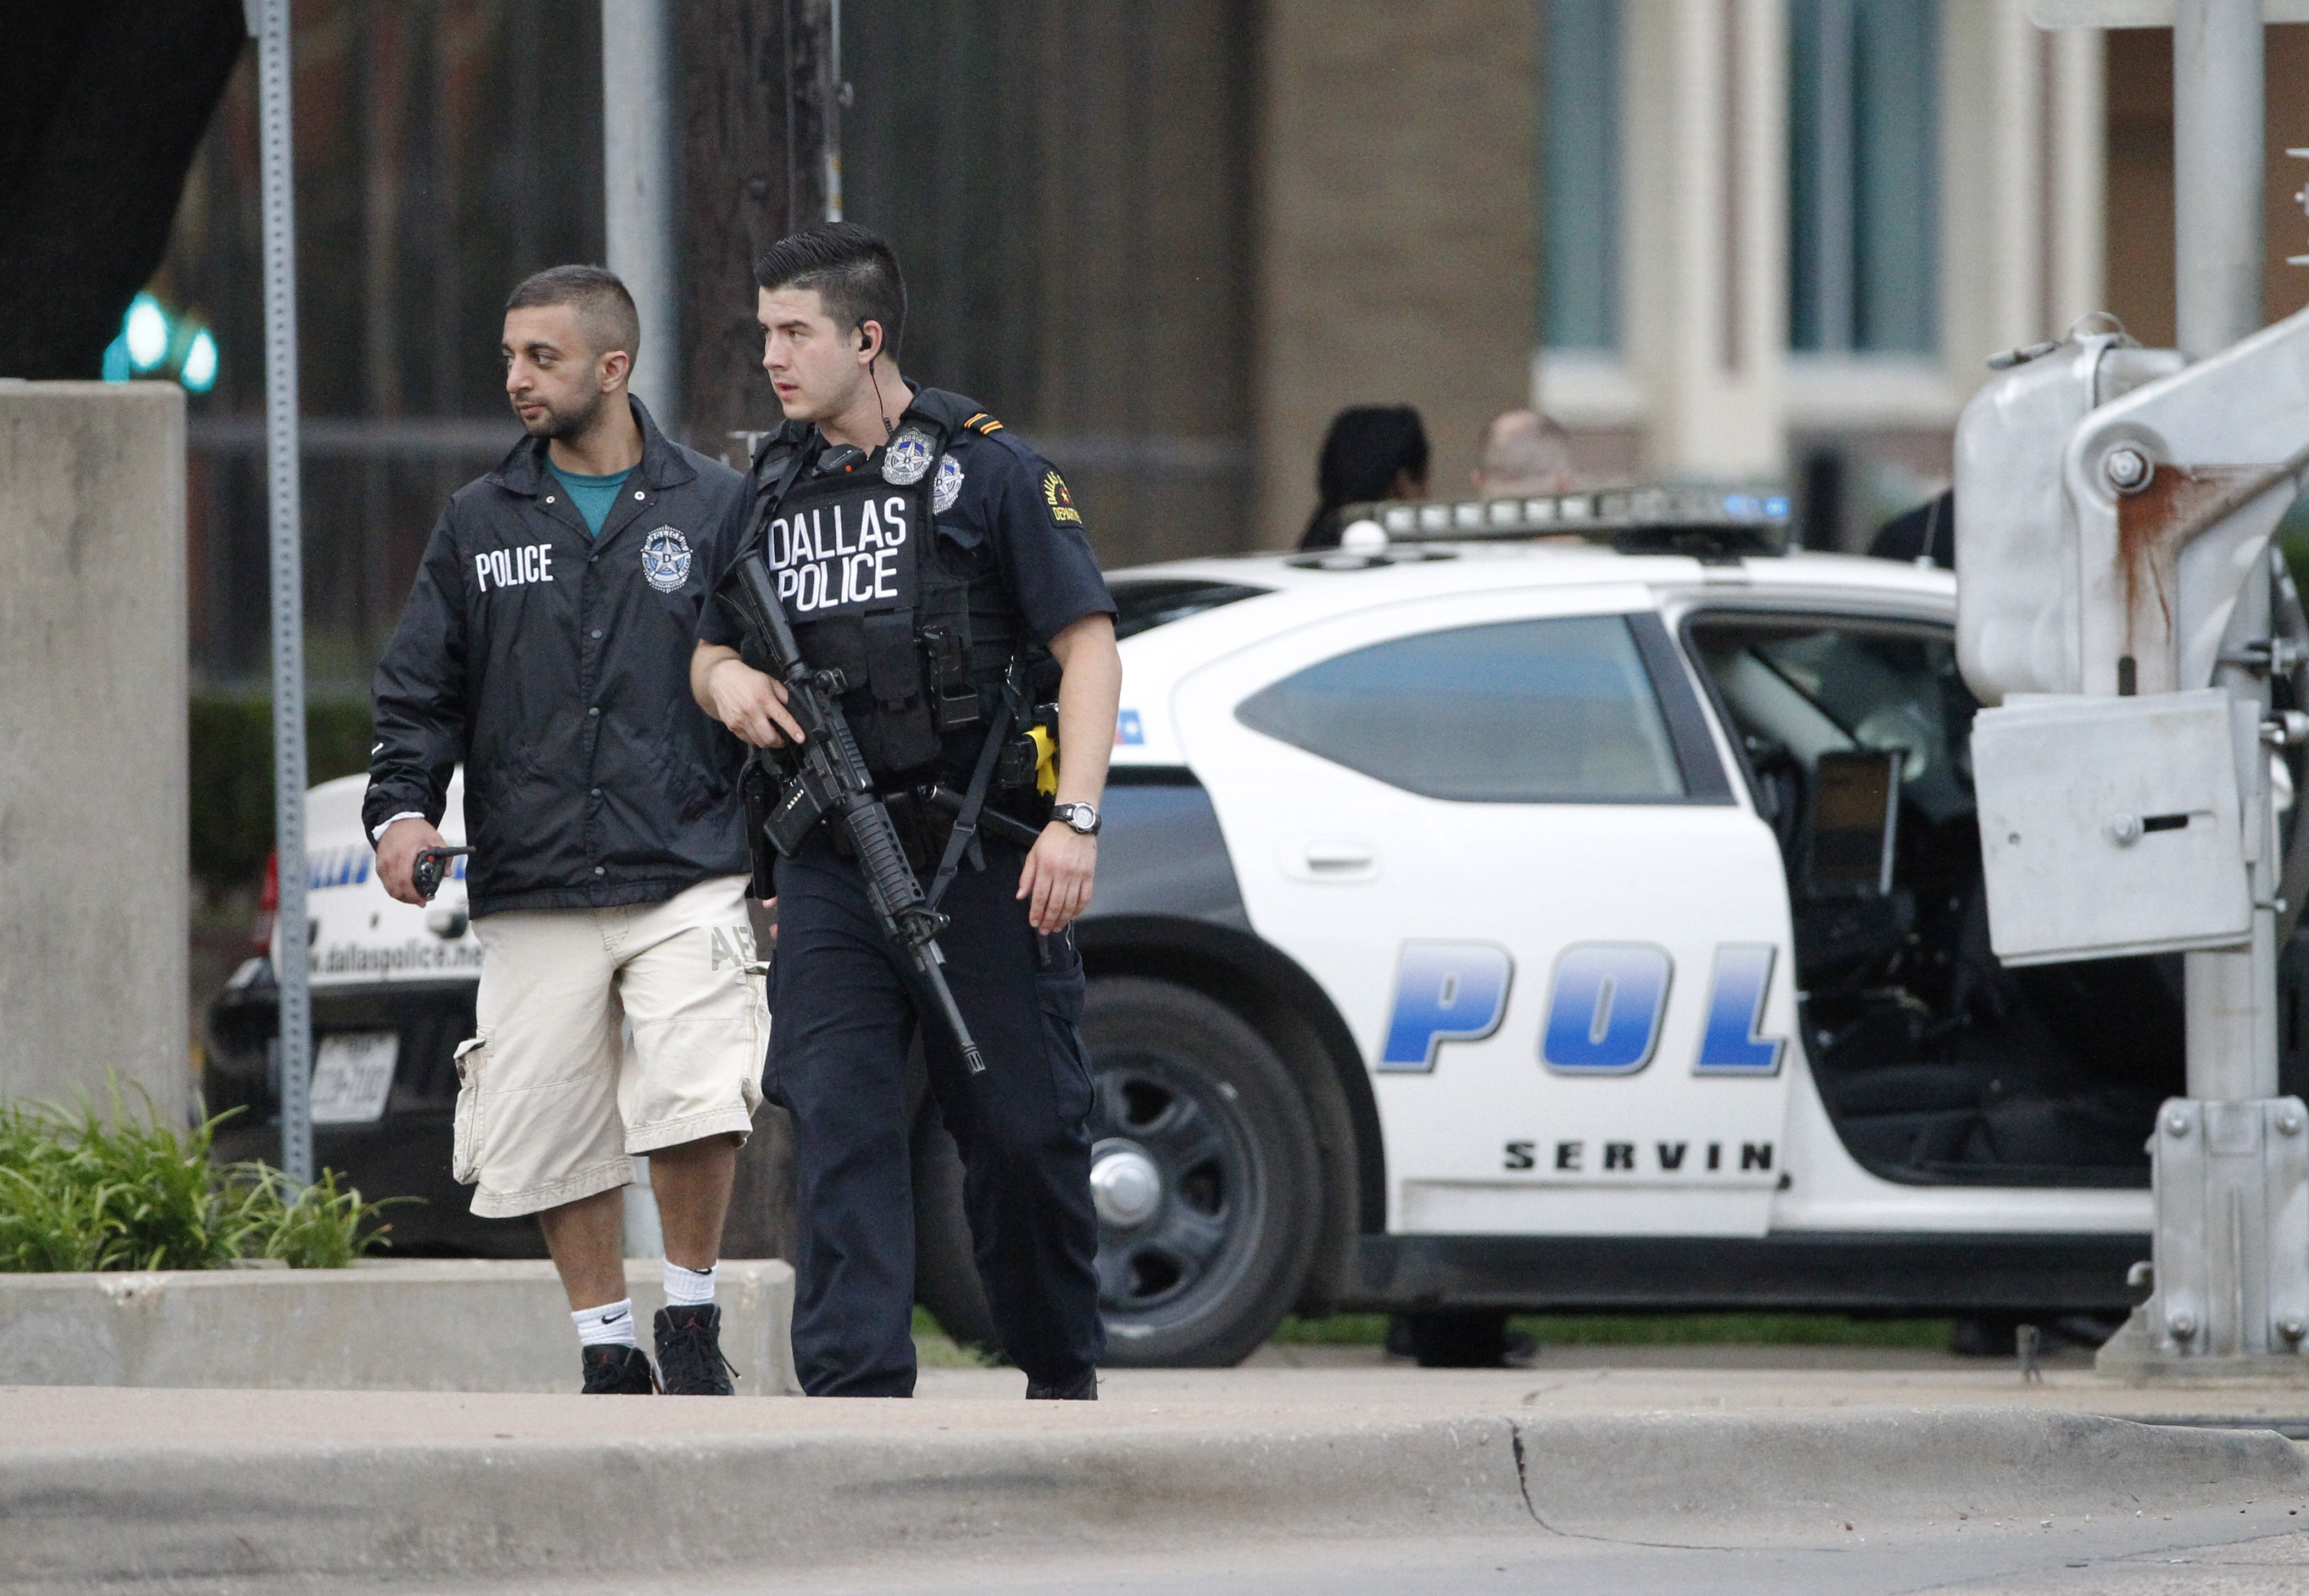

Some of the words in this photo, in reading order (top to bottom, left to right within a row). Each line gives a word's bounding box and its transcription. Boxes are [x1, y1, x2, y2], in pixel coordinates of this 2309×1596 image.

[902, 435, 925, 445] POLICE
[649, 531, 683, 541] POLICE
[768, 496, 906, 571] DALLAS
[475, 544, 554, 592] POLICE
[663, 553, 672, 563] D
[778, 548, 898, 611] POLICE
[1375, 938, 1786, 1077] POL
[1504, 1142, 1773, 1171] SERVIN
